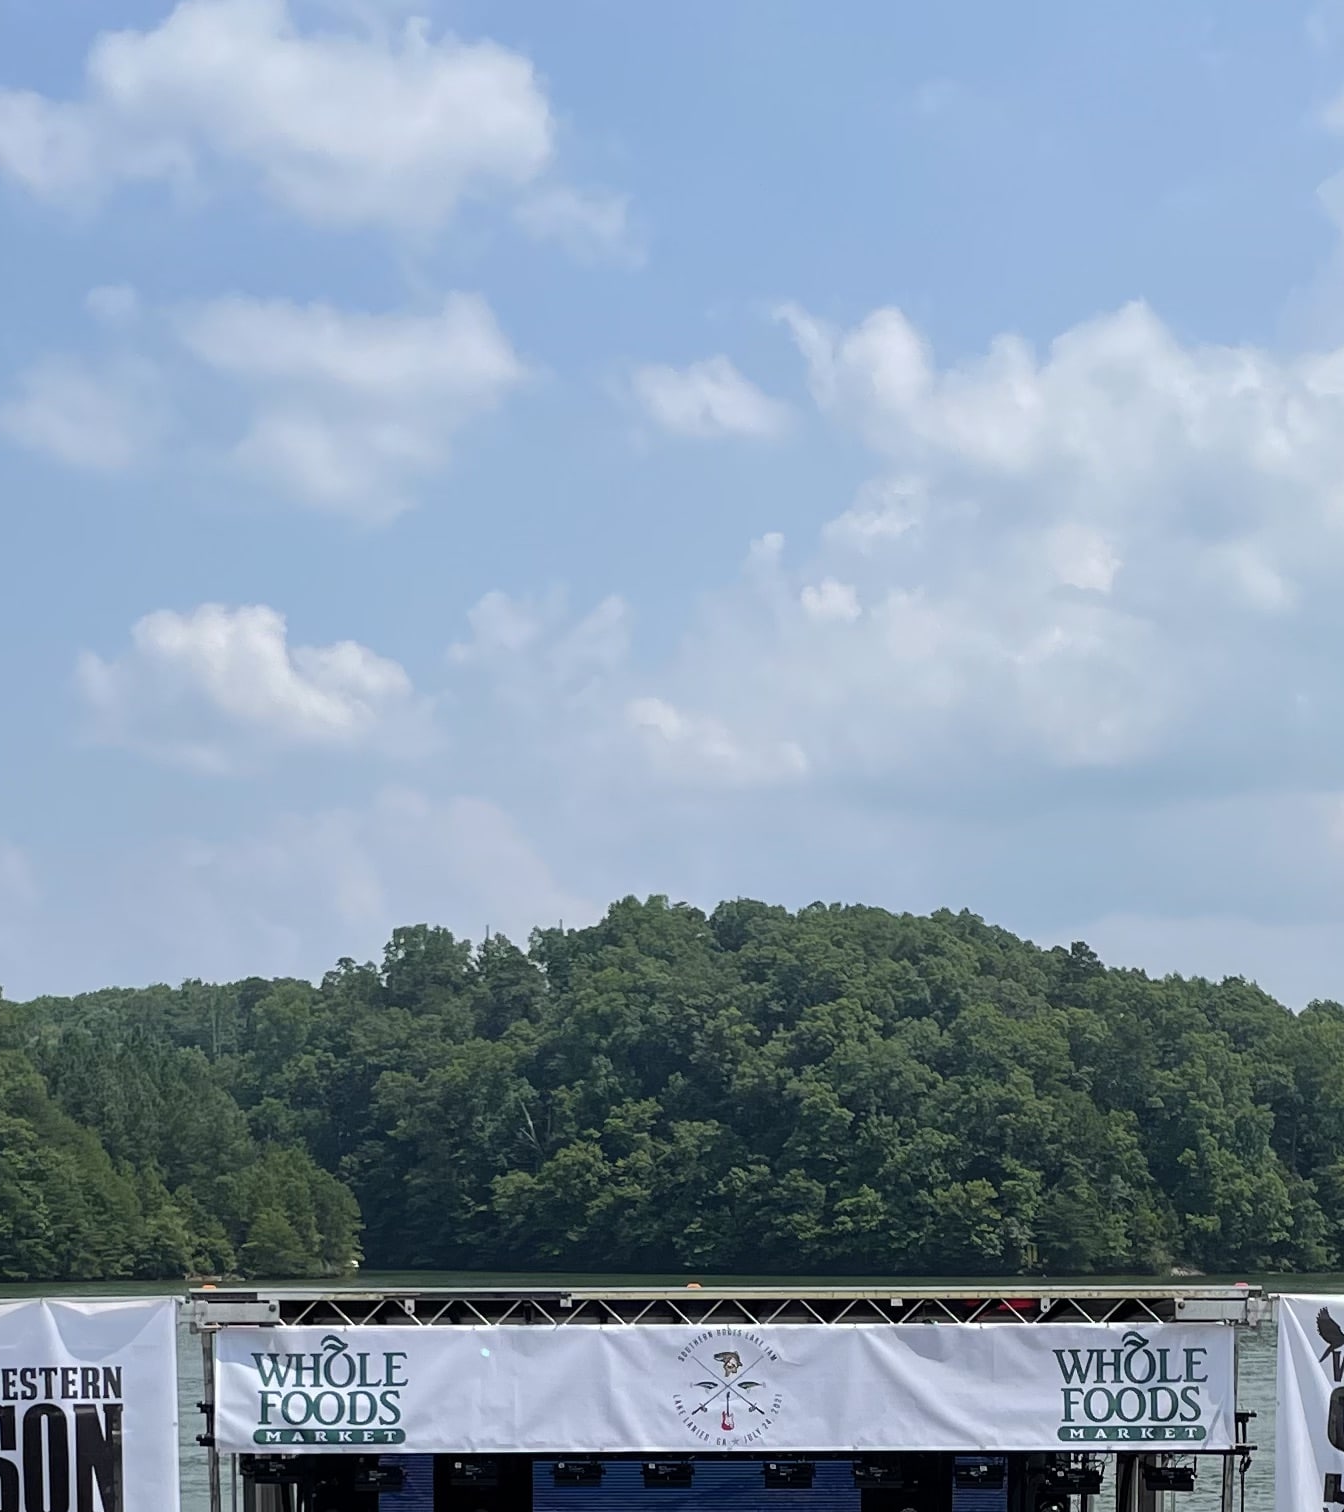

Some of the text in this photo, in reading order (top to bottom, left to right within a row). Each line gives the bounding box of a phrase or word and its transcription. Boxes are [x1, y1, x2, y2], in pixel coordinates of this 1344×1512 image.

[251, 1344, 409, 1388] WHOLE
[1052, 1340, 1208, 1385] WHOLE
[257, 1390, 402, 1426] FOODS
[1061, 1386, 1202, 1423] FOODS
[265, 1430, 398, 1443] MARKET
[1069, 1426, 1200, 1440] MARKET
